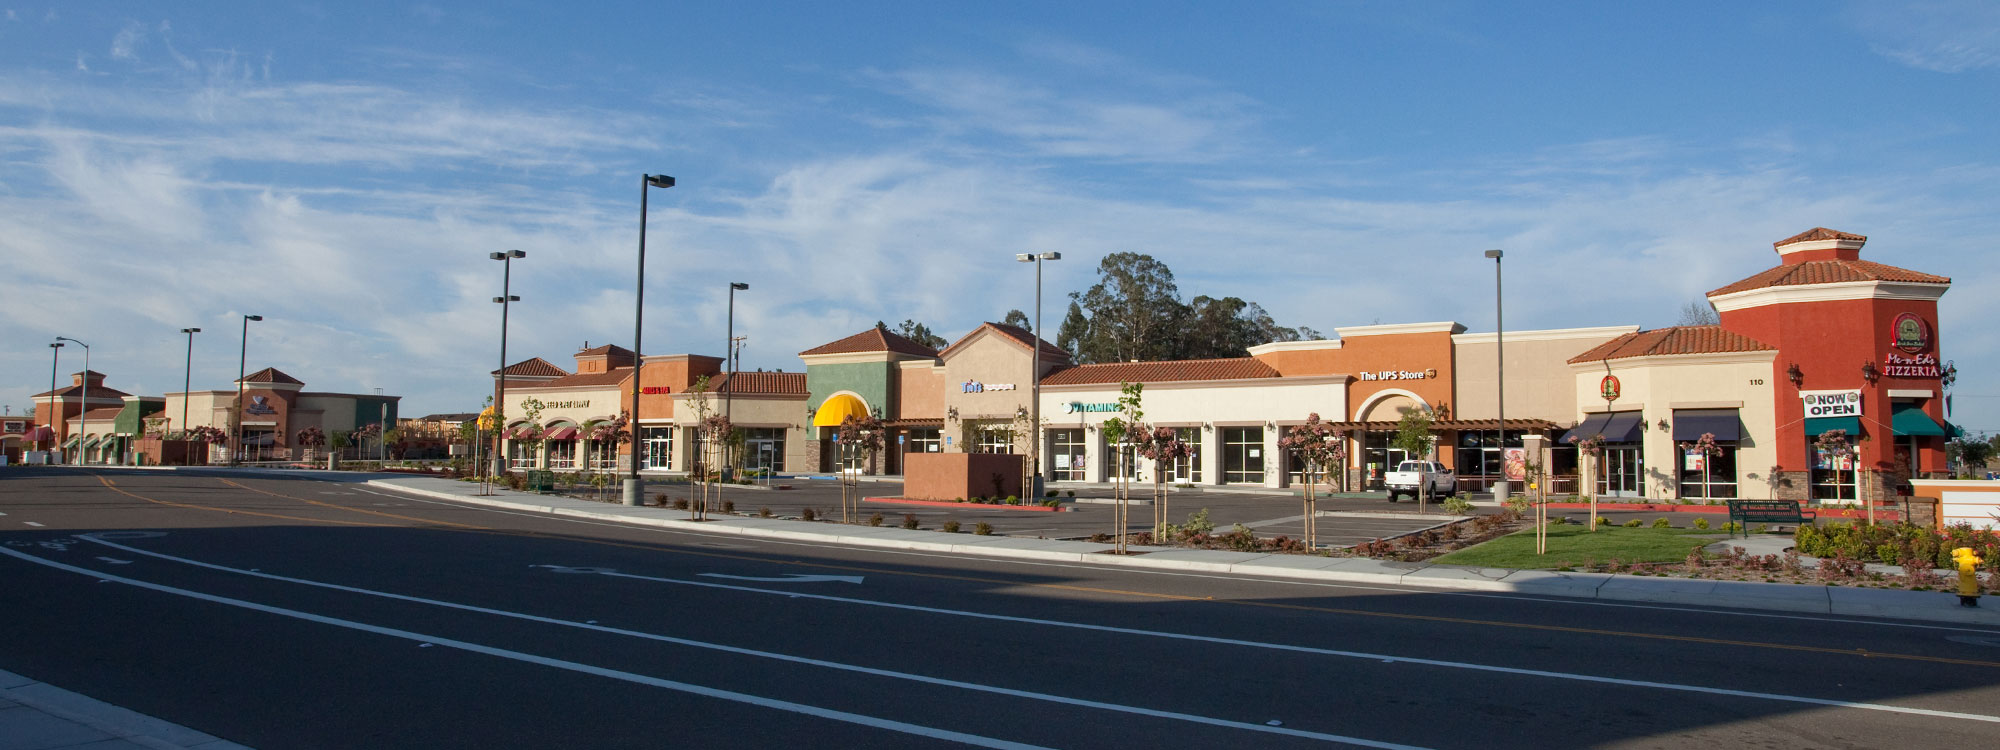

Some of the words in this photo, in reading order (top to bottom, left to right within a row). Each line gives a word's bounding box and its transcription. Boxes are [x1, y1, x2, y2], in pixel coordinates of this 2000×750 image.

[1360, 371, 1377, 381] The
[1379, 371, 1398, 380] UPS
[1400, 370, 1424, 379] Store
[1884, 366, 1939, 377] PIZZERIA
[1817, 394, 1846, 405] NOW
[1810, 405, 1855, 416] OPEN
